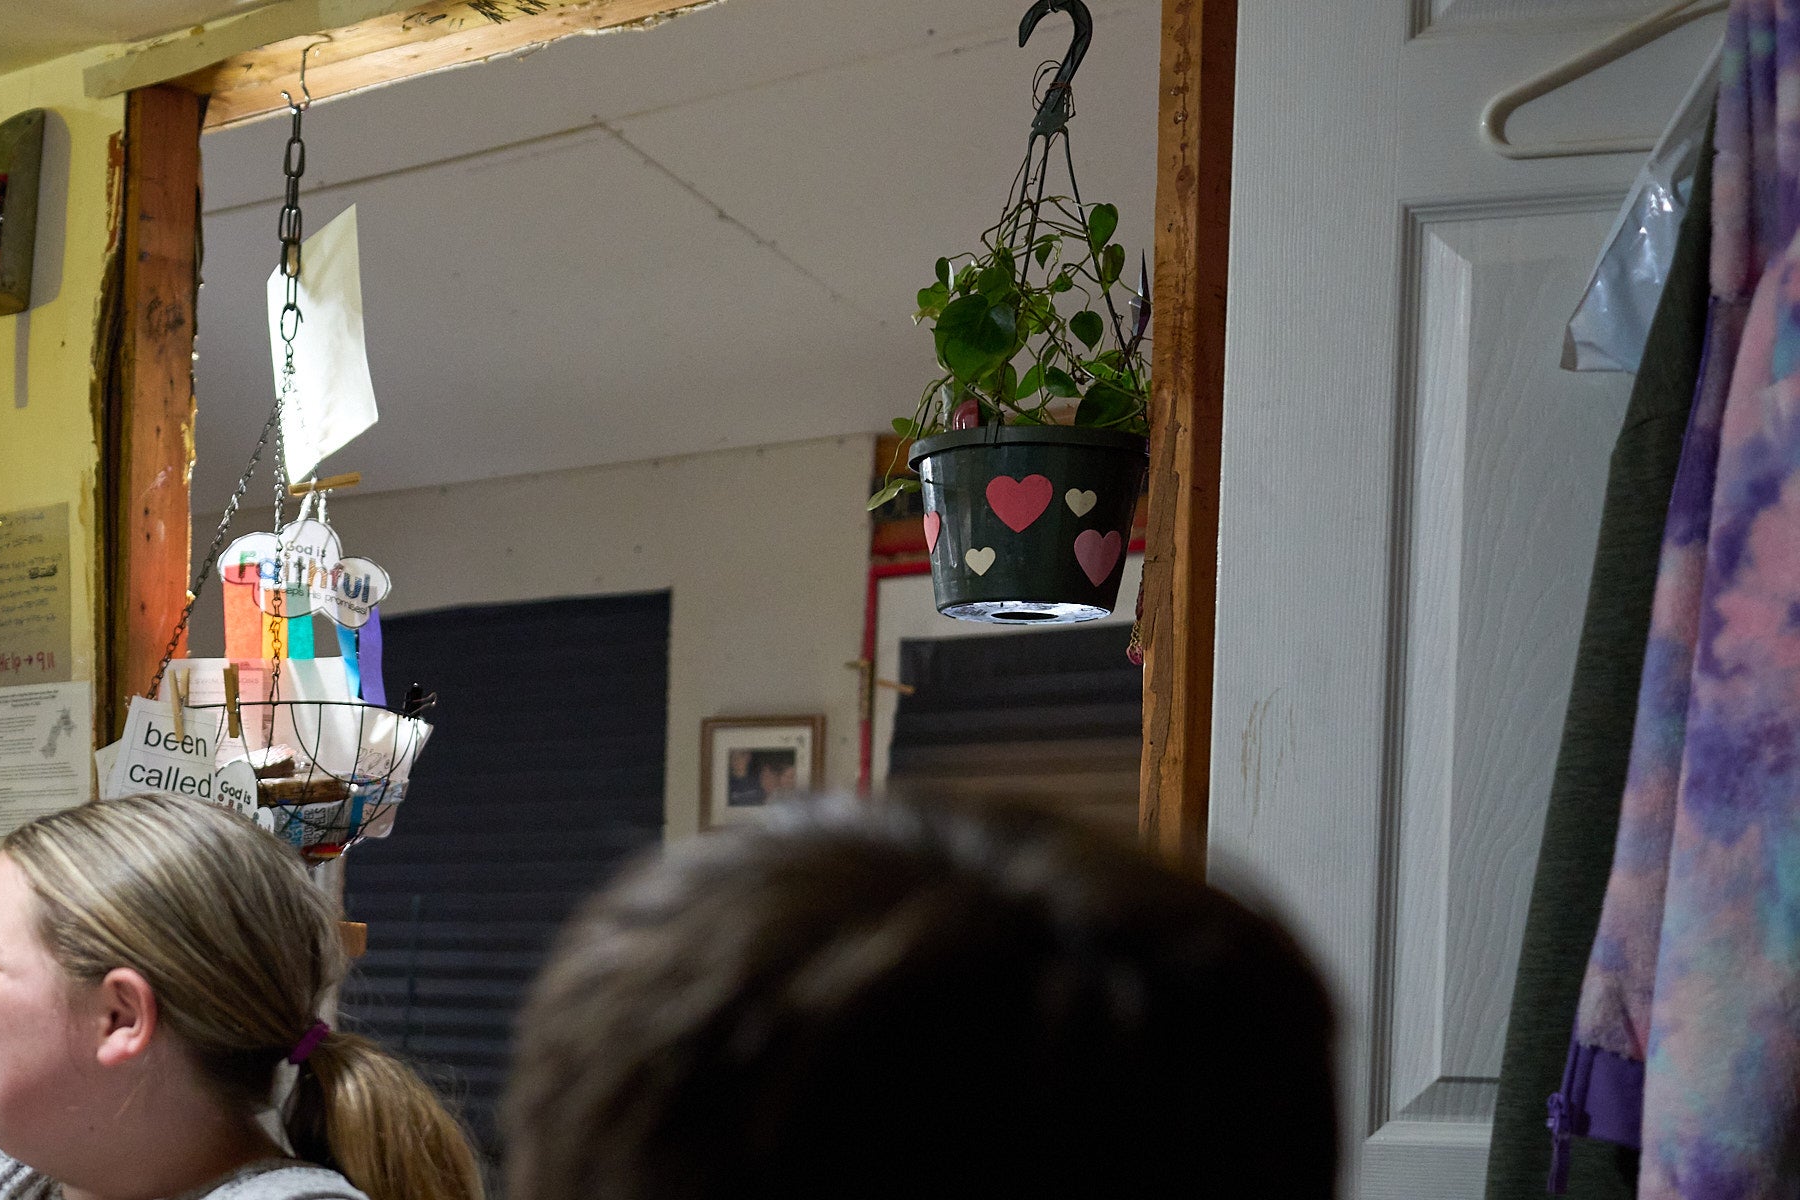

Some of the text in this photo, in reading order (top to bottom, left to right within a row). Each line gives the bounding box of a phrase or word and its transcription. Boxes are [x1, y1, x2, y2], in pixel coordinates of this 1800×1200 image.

[285, 541, 326, 558] God is
[239, 551, 371, 603] Faithful
[144, 721, 207, 758] been
[129, 763, 212, 799] called
[220, 780, 252, 806] God is
